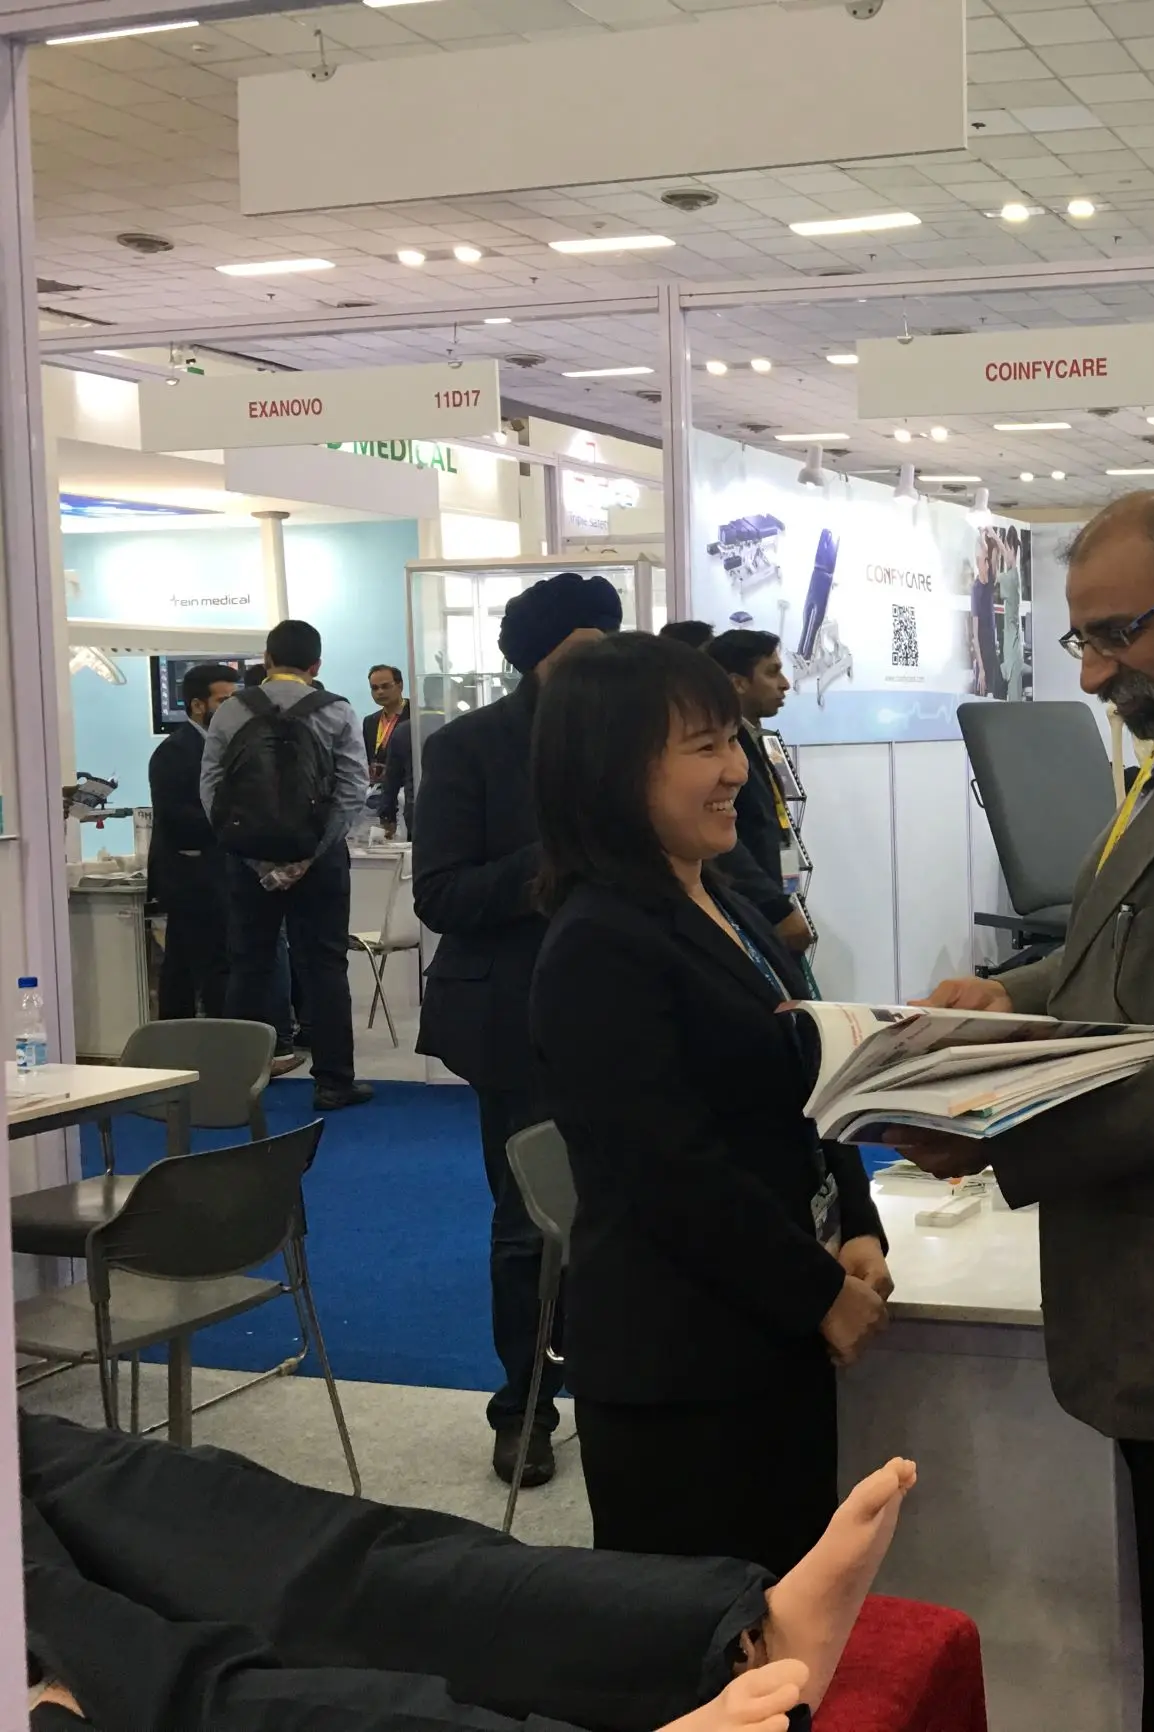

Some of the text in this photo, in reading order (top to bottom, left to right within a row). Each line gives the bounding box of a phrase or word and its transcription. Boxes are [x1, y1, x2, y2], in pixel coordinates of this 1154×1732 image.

[985, 357, 1108, 382] COINFYCARE
[248, 389, 481, 419] EXANOVO 11D17
[201, 593, 250, 606] medical
